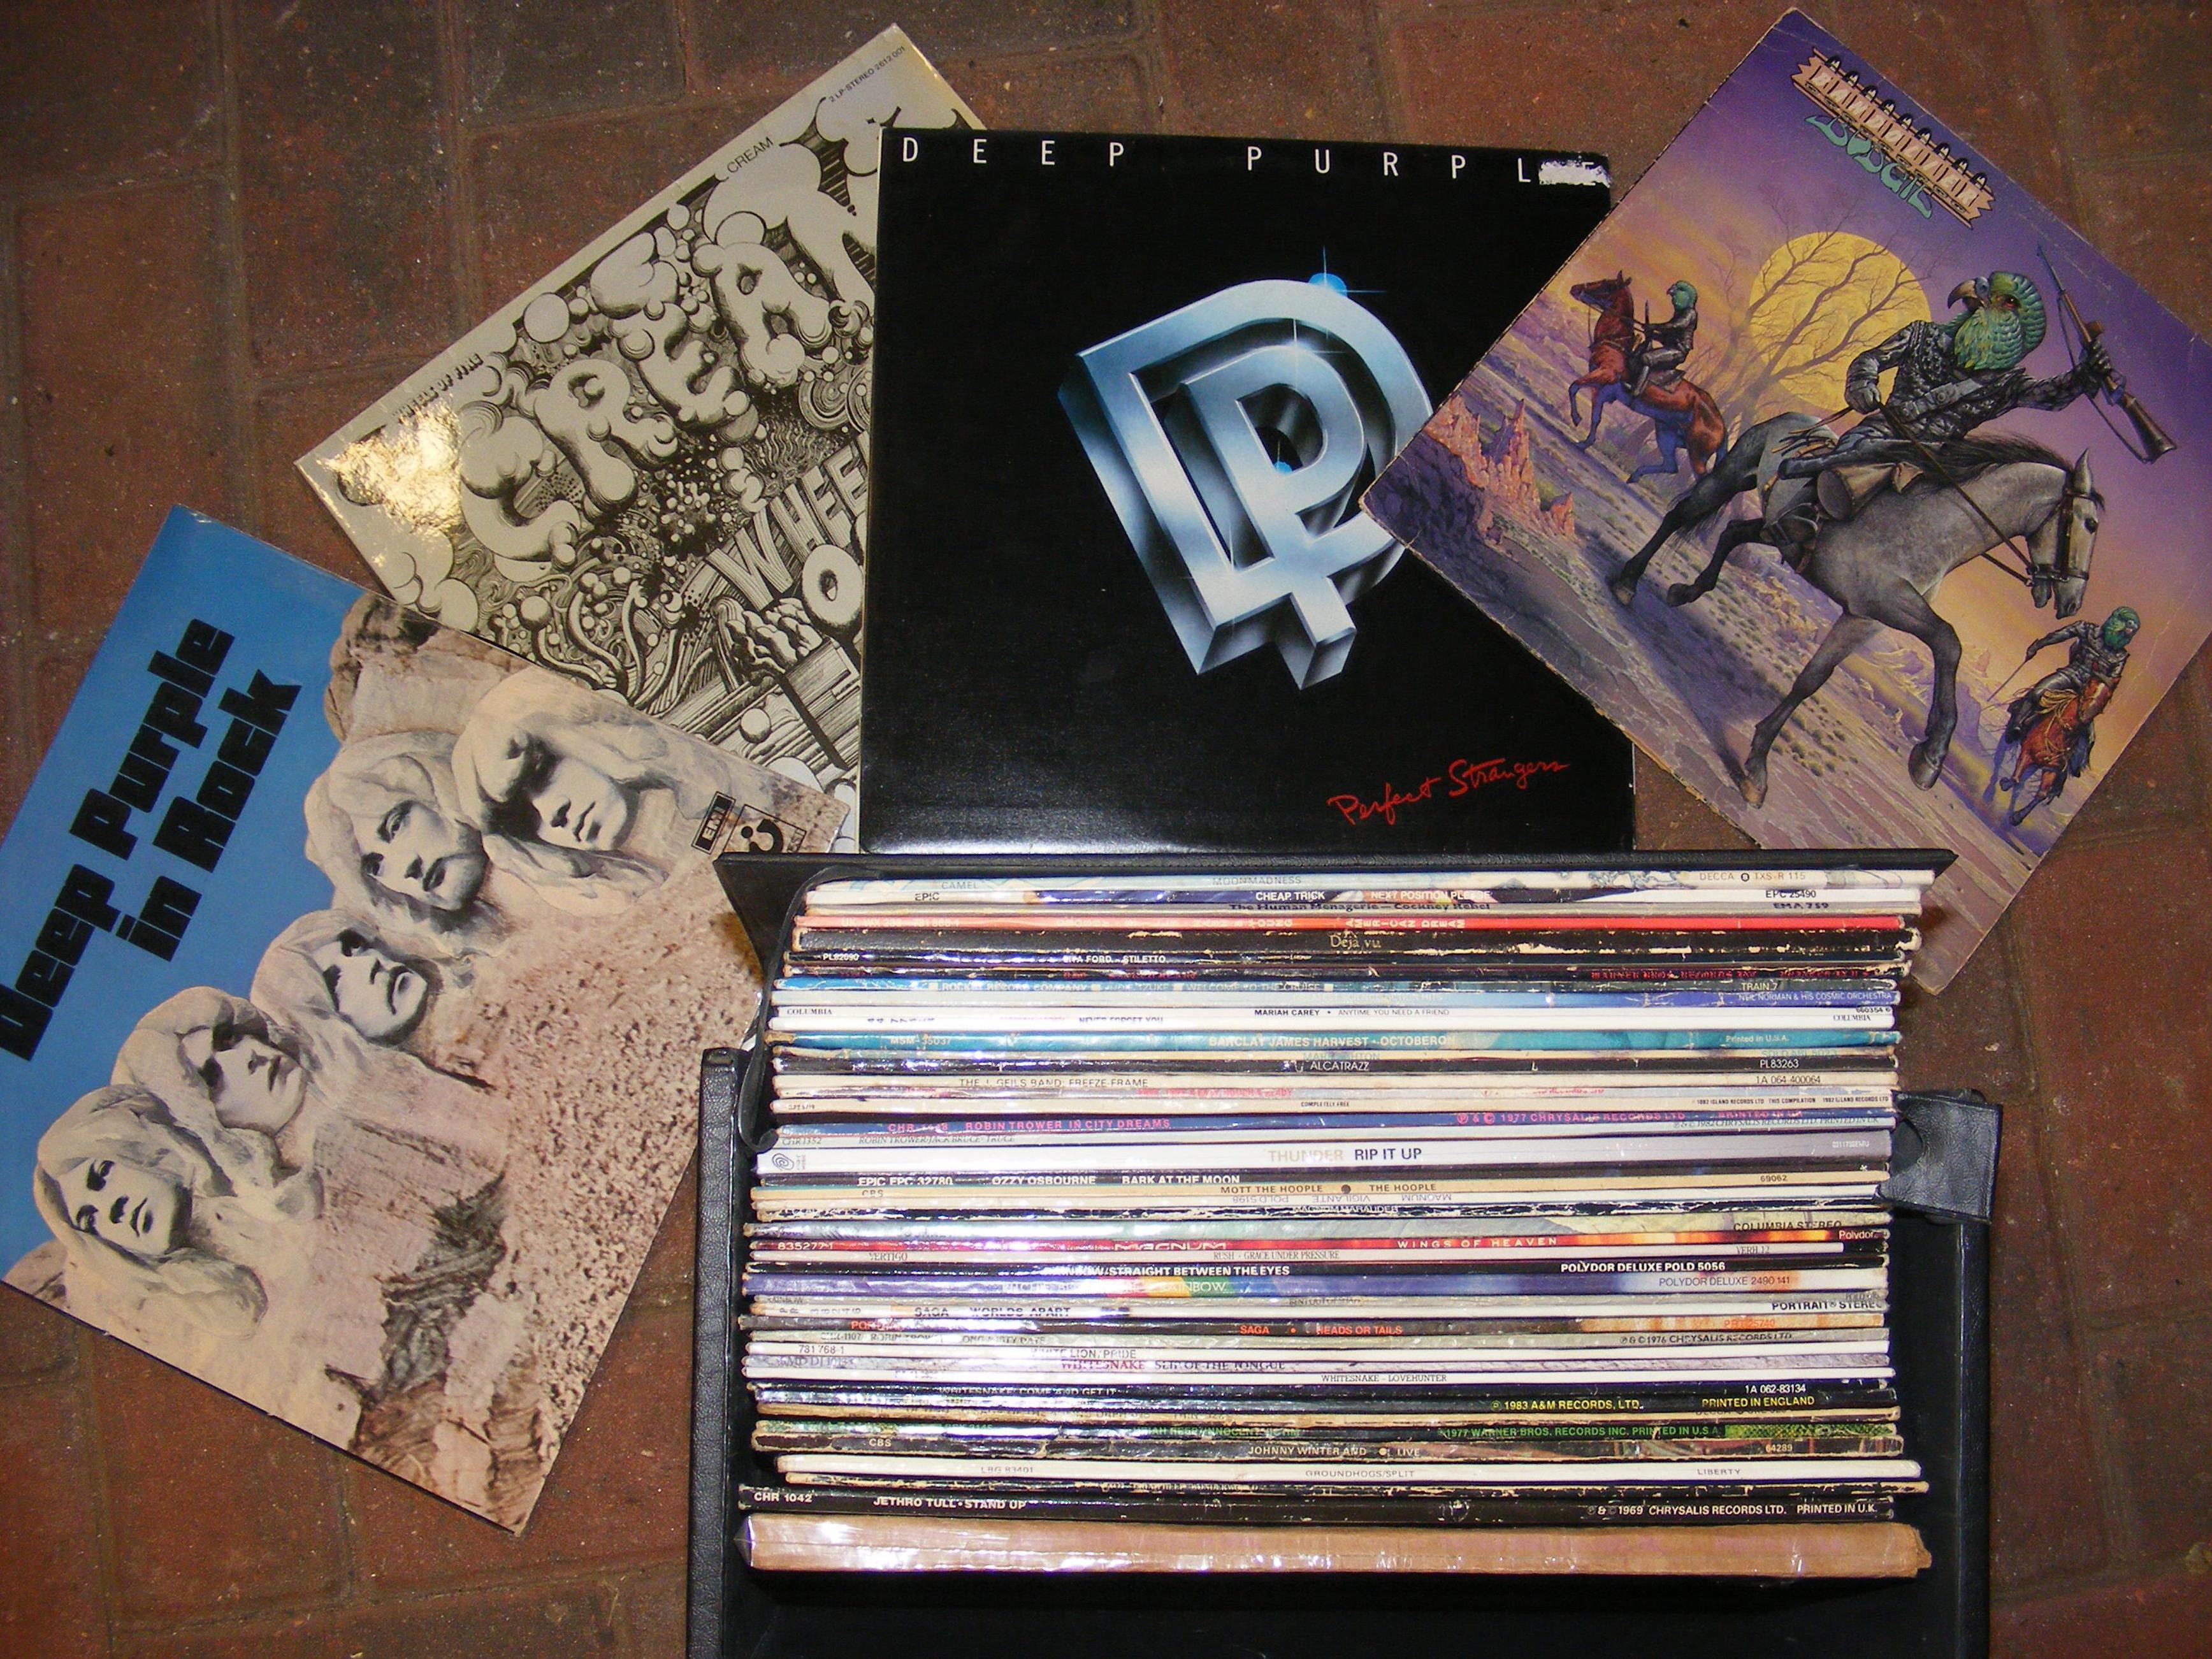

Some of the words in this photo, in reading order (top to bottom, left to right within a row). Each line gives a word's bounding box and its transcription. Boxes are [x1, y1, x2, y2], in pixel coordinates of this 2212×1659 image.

[726, 136, 774, 174] CREAM
[902, 136, 1124, 167] DEEP
[69, 618, 235, 860] Purple
[1327, 782, 1442, 825] Perfect
[1449, 758, 1571, 797] Strangers
[702, 806, 726, 841] EMI
[941, 881, 978, 890] CAMEL
[1213, 876, 1301, 885] MOONMADNESS
[1699, 872, 1734, 881] DECCA
[1788, 872, 1805, 880] 115
[914, 892, 940, 901] EPIC
[1294, 891, 1325, 900] TRICK
[1399, 891, 1447, 900] POSITION
[1765, 890, 1787, 899] EPC
[1789, 890, 1816, 899] 25490
[116, 875, 202, 962] in
[1345, 918, 1416, 928] AMERICAN
[1421, 919, 1466, 928] DREAM
[1209, 1036, 1265, 1047] BARCLAY
[1269, 1036, 1309, 1047] JAMES
[1313, 1037, 1368, 1047] HARVEST
[1726, 1034, 1754, 1043] Printed
[1310, 1061, 1370, 1071] ALCATRAZZ
[1760, 1059, 1799, 1068] PL83263
[997, 1079, 1027, 1087] GEILS
[964, 1122, 1005, 1130] ROBIN
[1009, 1120, 1063, 1129] TROWER
[1068, 1120, 1081, 1129] IN
[1086, 1119, 1113, 1129] CITY
[1117, 1119, 1170, 1128] DREAMS
[1500, 1114, 1527, 1122] 1977
[1665, 1112, 1686, 1120] LTD
[1268, 1150, 1343, 1162] THUNDER
[1354, 1149, 1378, 1160] RIP
[1383, 1148, 1396, 1160] IT
[1401, 1148, 1422, 1160] UP
[857, 1177, 886, 1186] EPIC
[992, 1176, 1025, 1185] OZZY
[1027, 1176, 1096, 1185] OSBOURNE
[1122, 1175, 1155, 1184] BARK
[1159, 1175, 1173, 1184] AT
[1176, 1175, 1200, 1184] THE
[1204, 1175, 1240, 1184] MOON
[1220, 1185, 1252, 1194] MOTT
[1280, 1184, 1323, 1193] HOOPLE
[1394, 1183, 1436, 1191] HOOPLE
[1461, 1239, 1480, 1247] OF
[1491, 1237, 1557, 1247] HEAVEN
[869, 1252, 908, 1261] VERTIGO
[1213, 1251, 1234, 1260] RUSH
[1244, 1251, 1269, 1260] GRACE
[1271, 1250, 1299, 1259] UNDER
[1301, 1250, 1339, 1259] PRESSURE
[1173, 1266, 1231, 1276] BETWEEN
[1233, 1266, 1258, 1275] THE
[1259, 1266, 1290, 1275] EYES
[1561, 1263, 1615, 1273] POLYDOR
[1617, 1263, 1662, 1272] DELUXE
[1665, 1262, 1695, 1271] POLD
[1697, 1262, 1726, 1271] 5056
[1659, 1277, 1708, 1287] POLYDOR
[1709, 1277, 1748, 1286] DELUXE
[1751, 1277, 1774, 1286] 2490
[1777, 1276, 1790, 1285] 141
[1240, 1325, 1269, 1335] SAGA
[1316, 1325, 1353, 1335] HEADS
[1355, 1325, 1371, 1335] OR
[1373, 1325, 1403, 1335] TAILS
[799, 1344, 815, 1354] 781
[1744, 1385, 1758, 1393] 1A
[1760, 1384, 1806, 1393] 062-83134
[1504, 1401, 1528, 1410] 1983
[1531, 1401, 1556, 1410] A&M
[1702, 1398, 1748, 1407] PRINTED
[1749, 1398, 1761, 1407] IN
[1763, 1396, 1815, 1407] ENGLAND
[1555, 1427, 1605, 1436] RECORDS
[1608, 1427, 1630, 1436] INC.
[1679, 1426, 1689, 1435] IN
[869, 1438, 892, 1447] CBS
[1248, 1447, 1294, 1456] JOHNNY
[1297, 1447, 1339, 1456] WINTER
[1343, 1447, 1367, 1456] AND
[1396, 1448, 1420, 1456] LIVE
[1765, 1444, 1793, 1453] 64289
[1305, 1470, 1415, 1478] GROUNDHOGS/SPLIT
[754, 1493, 779, 1502] CHR
[784, 1493, 813, 1503] 1042
[873, 1496, 923, 1507] JETHRO
[1009, 1500, 1027, 1510] UP
[1597, 1505, 1607, 1515] &
[1619, 1505, 1644, 1515] 1969
[1648, 1505, 1710, 1516] CHRYSALIS
[1712, 1505, 1763, 1516] RECORDS
[1765, 1504, 1787, 1515] LTD.
[1796, 1503, 1842, 1514] PRINTED
[1844, 1503, 1856, 1513] IN
[1858, 1503, 1878, 1513] U.K.
